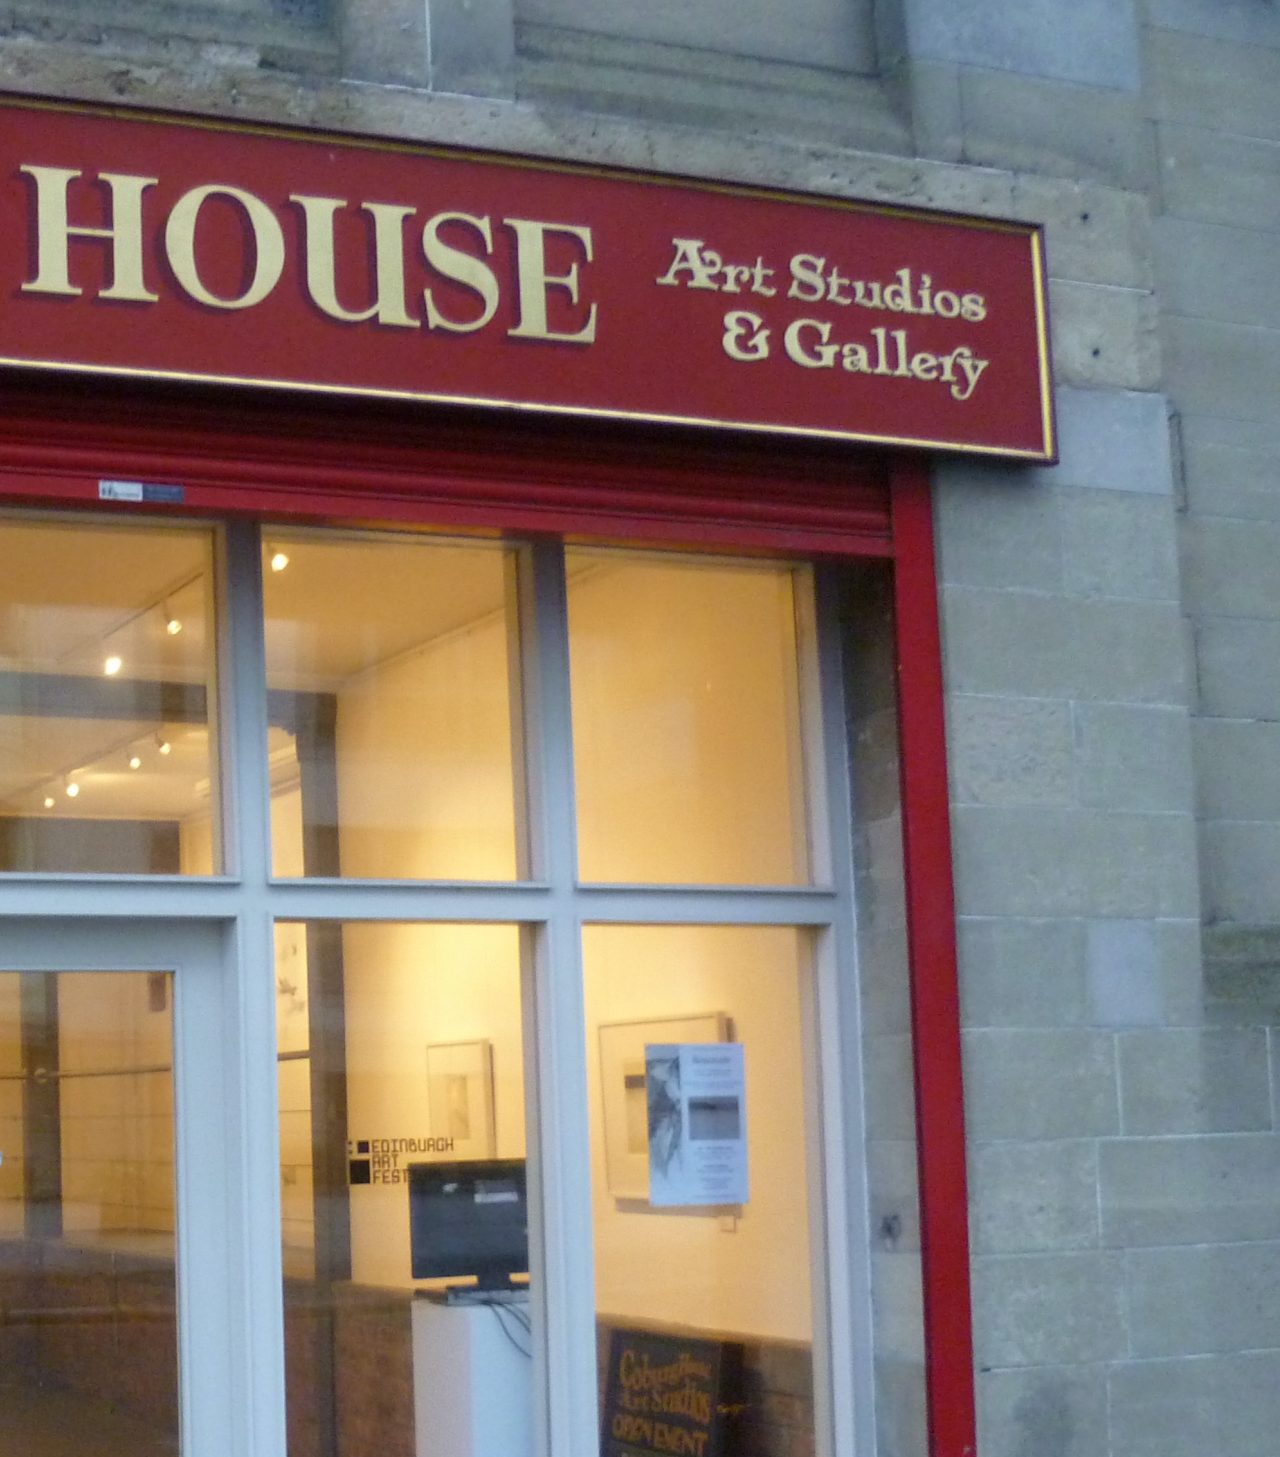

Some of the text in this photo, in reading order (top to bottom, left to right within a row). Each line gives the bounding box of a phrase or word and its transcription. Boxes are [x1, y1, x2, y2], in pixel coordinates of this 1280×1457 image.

[19, 164, 599, 346] HOUSE
[656, 238, 988, 322] Art Studios
[722, 310, 989, 400] & Gallery
[372, 1154, 399, 1168] ART
